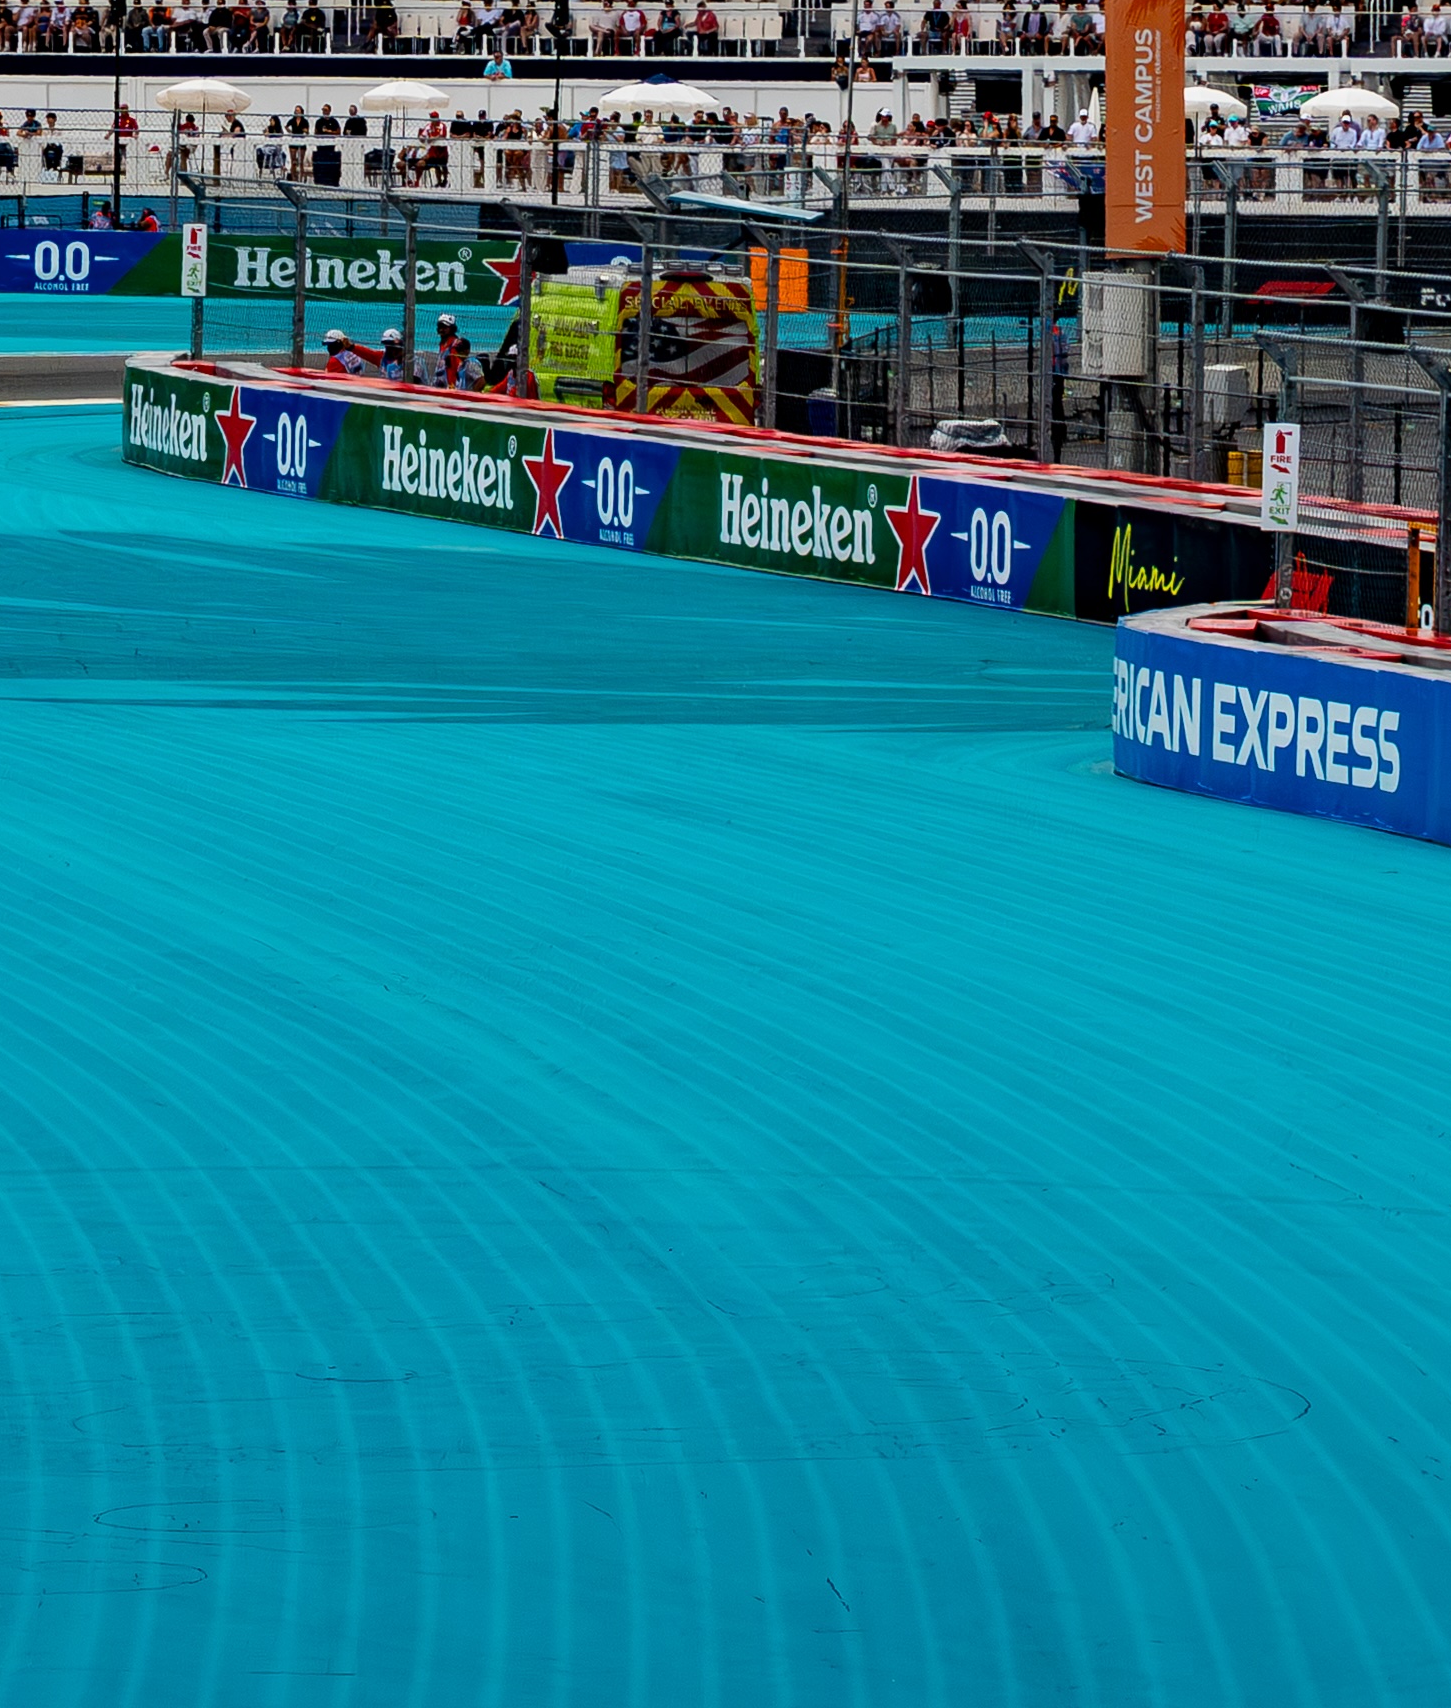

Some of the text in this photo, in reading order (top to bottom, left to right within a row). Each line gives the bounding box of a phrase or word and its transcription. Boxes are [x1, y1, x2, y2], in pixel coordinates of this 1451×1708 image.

[1134, 28, 1154, 224] WEST CAMPUS
[34, 241, 90, 281] 0.0
[34, 281, 90, 291] ALCOHOL FREE
[625, 295, 686, 311] SPCIAL
[277, 412, 307, 478] 0.0
[1270, 455, 1292, 464] FIRE
[597, 457, 634, 528] 0.0
[1269, 506, 1291, 516] EXIT
[970, 507, 1012, 585] 0.0
[1108, 523, 1186, 613] Miami
[970, 585, 1012, 604] ALCOHOL FREE
[1212, 682, 1401, 793] EXPRESS
